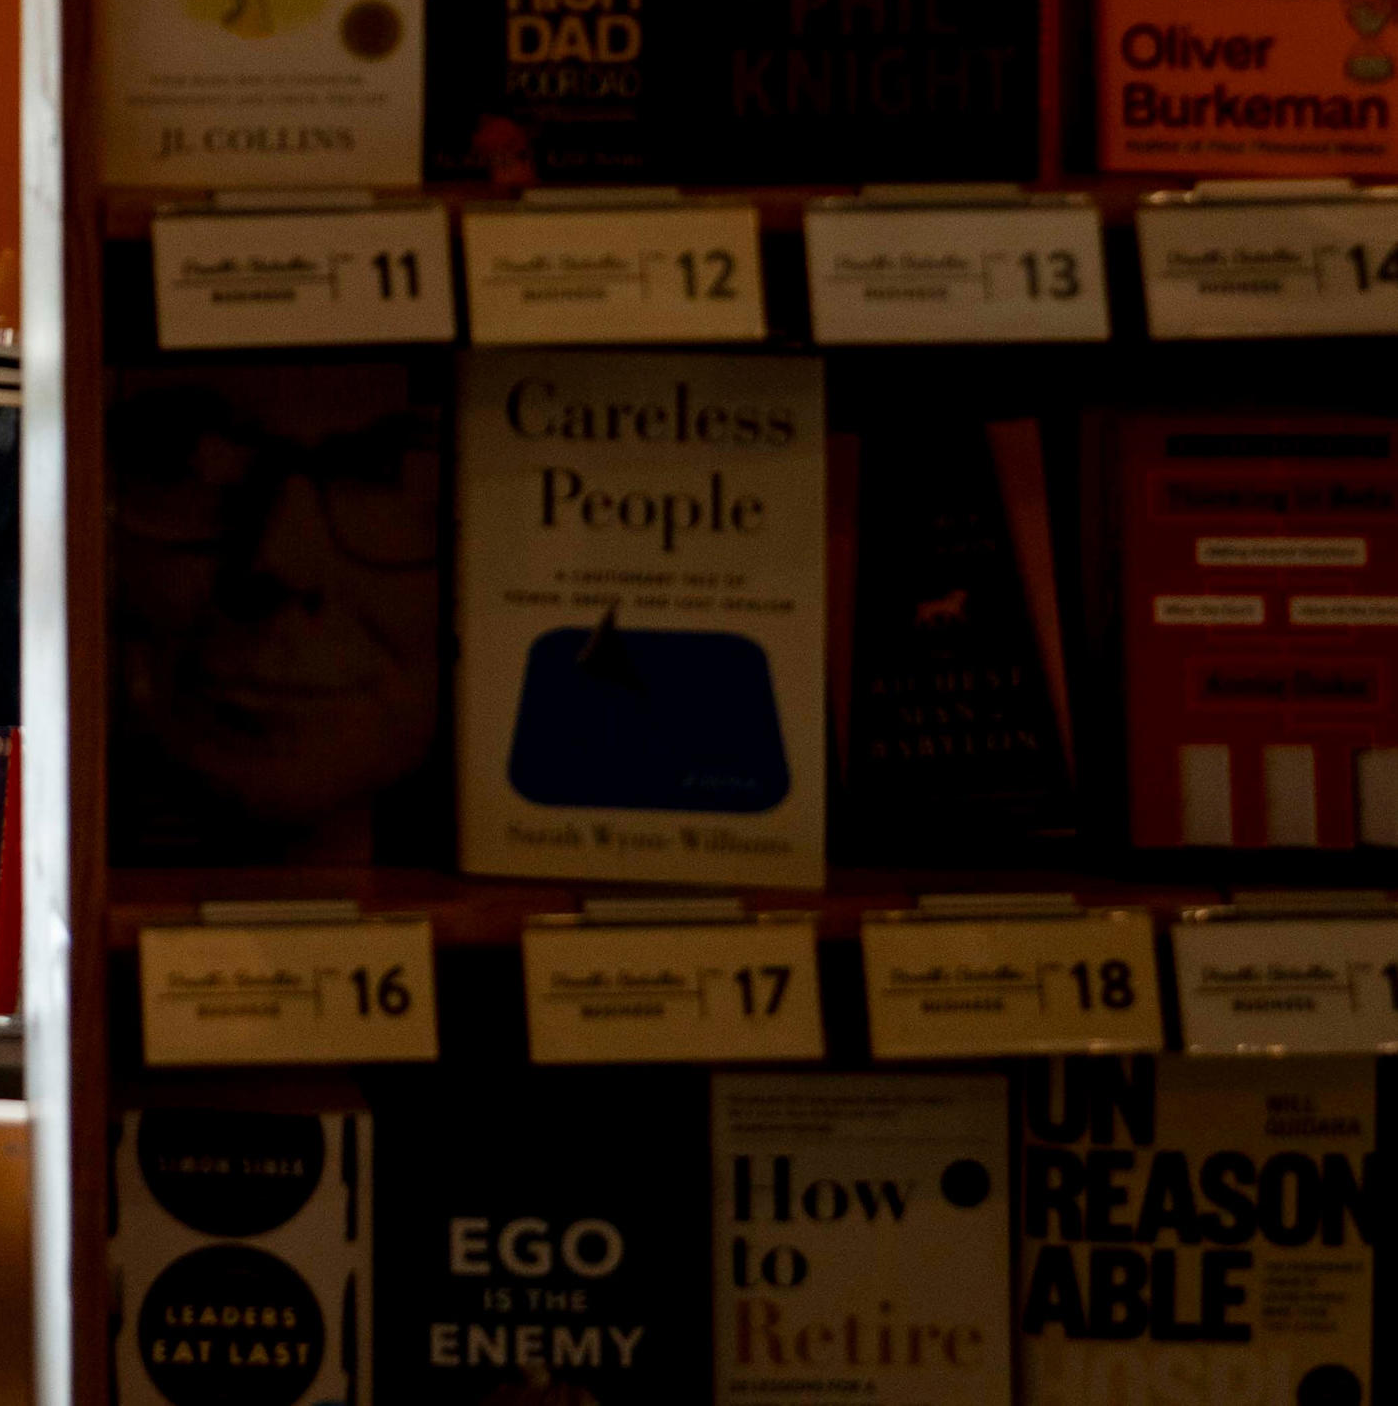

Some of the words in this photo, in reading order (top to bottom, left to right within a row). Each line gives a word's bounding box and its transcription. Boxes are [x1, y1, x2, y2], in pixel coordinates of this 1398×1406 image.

[506, 14, 643, 64] DAD
[1120, 22, 1274, 72] Oliver
[730, 45, 1018, 118] KNIGHT
[1122, 82, 1389, 130] Burkeman
[204, 124, 356, 154] COLLINS
[372, 251, 421, 302] 11
[676, 249, 738, 302] 12
[1016, 250, 1080, 300] 13
[506, 375, 797, 448] Careless
[540, 466, 765, 553] People
[348, 965, 412, 1018] 16
[732, 965, 792, 1017] 17
[1069, 959, 1135, 1011] 18
[1024, 1055, 1156, 1146] UN
[734, 1155, 916, 1222] How
[1025, 1151, 1384, 1246] REASON
[446, 1214, 627, 1281] EGO
[733, 1236, 808, 1288] to
[163, 1304, 299, 1330] LEADERS
[482, 1286, 514, 1314] IS
[524, 1286, 588, 1314] THE
[1024, 1247, 1252, 1341] ABLE
[151, 1337, 213, 1367] EAT
[227, 1339, 311, 1369] LAST
[427, 1321, 647, 1370] ENEMY
[735, 1297, 984, 1367] Retire
